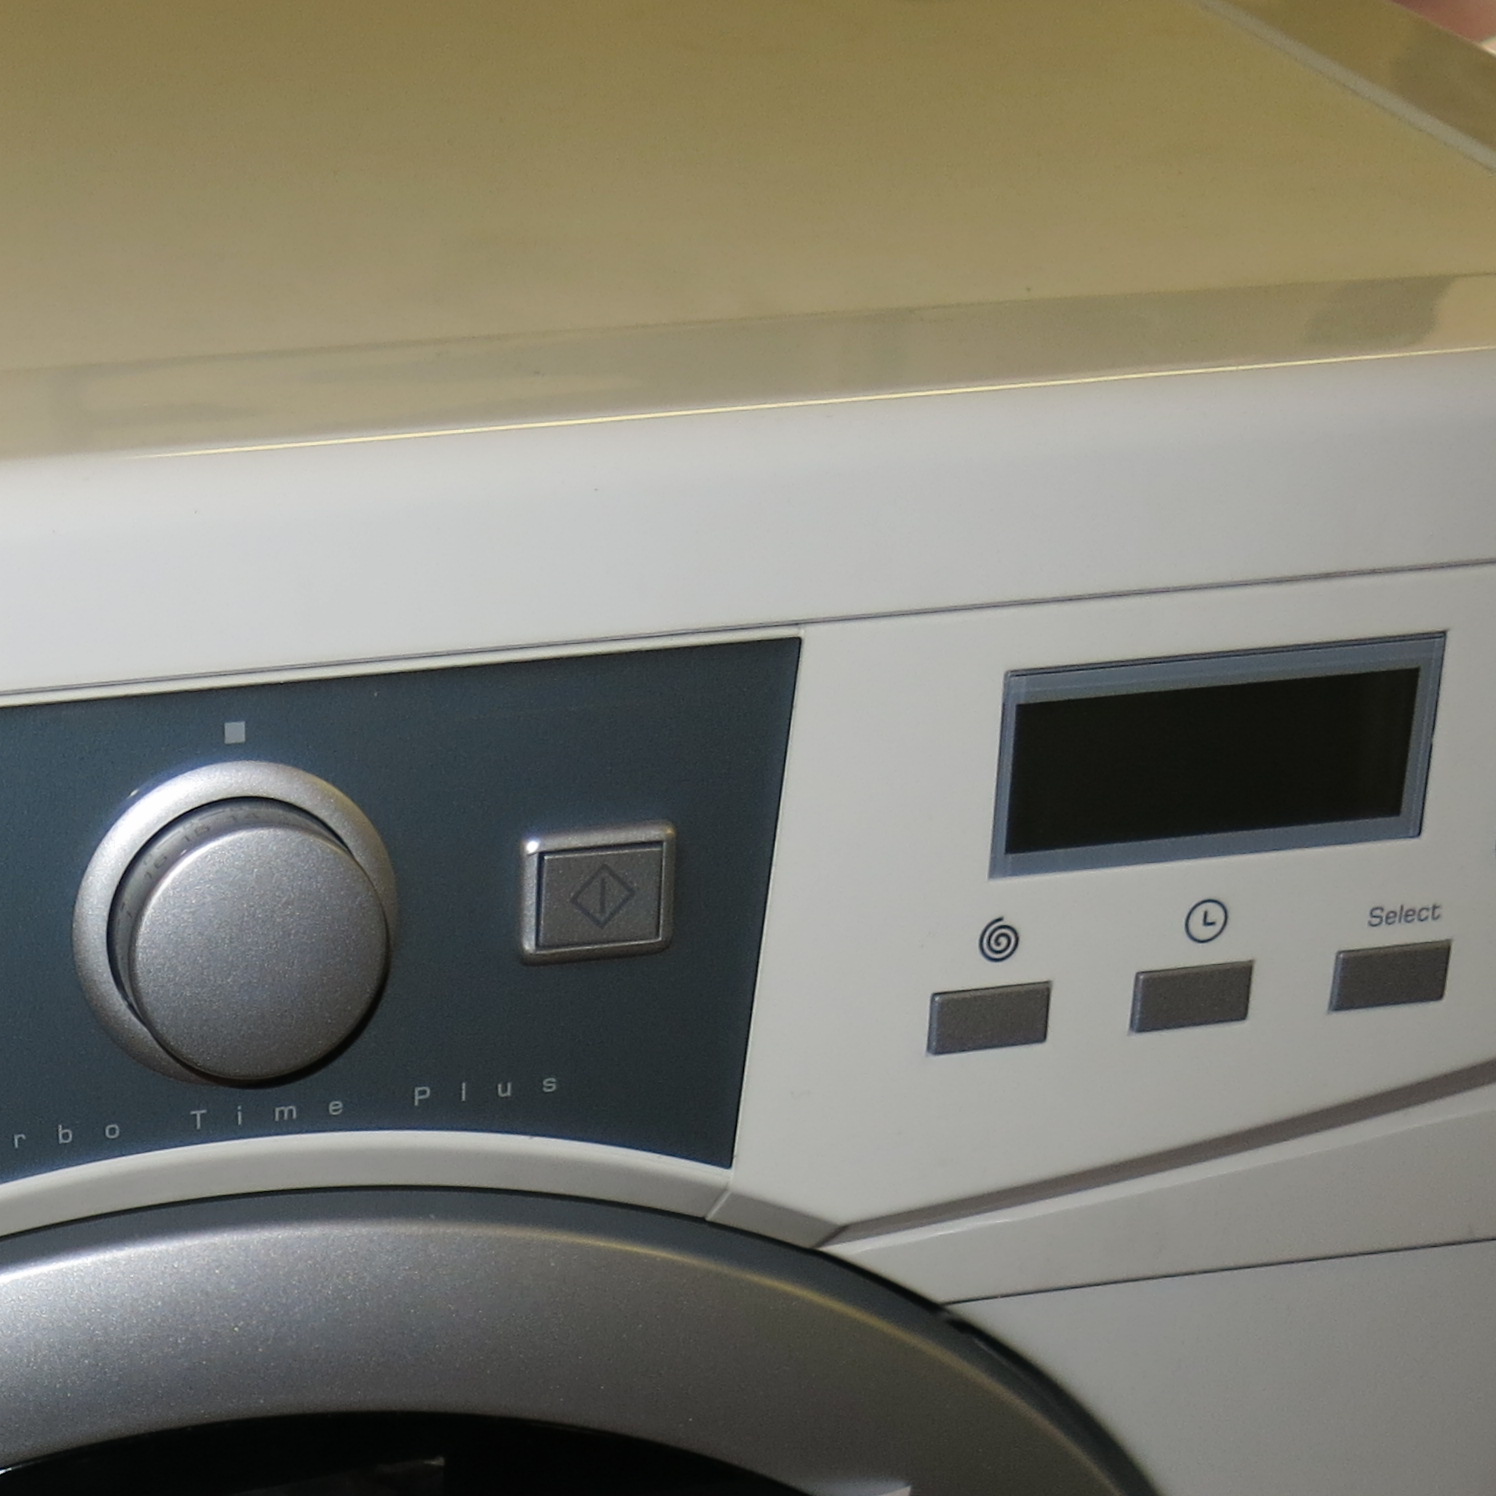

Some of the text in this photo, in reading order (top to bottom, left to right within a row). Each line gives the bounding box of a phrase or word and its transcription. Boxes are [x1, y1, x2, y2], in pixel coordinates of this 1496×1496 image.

[1368, 904, 1442, 927] Select
[190, 1099, 344, 1130] Time
[413, 1076, 558, 1107] Plus
